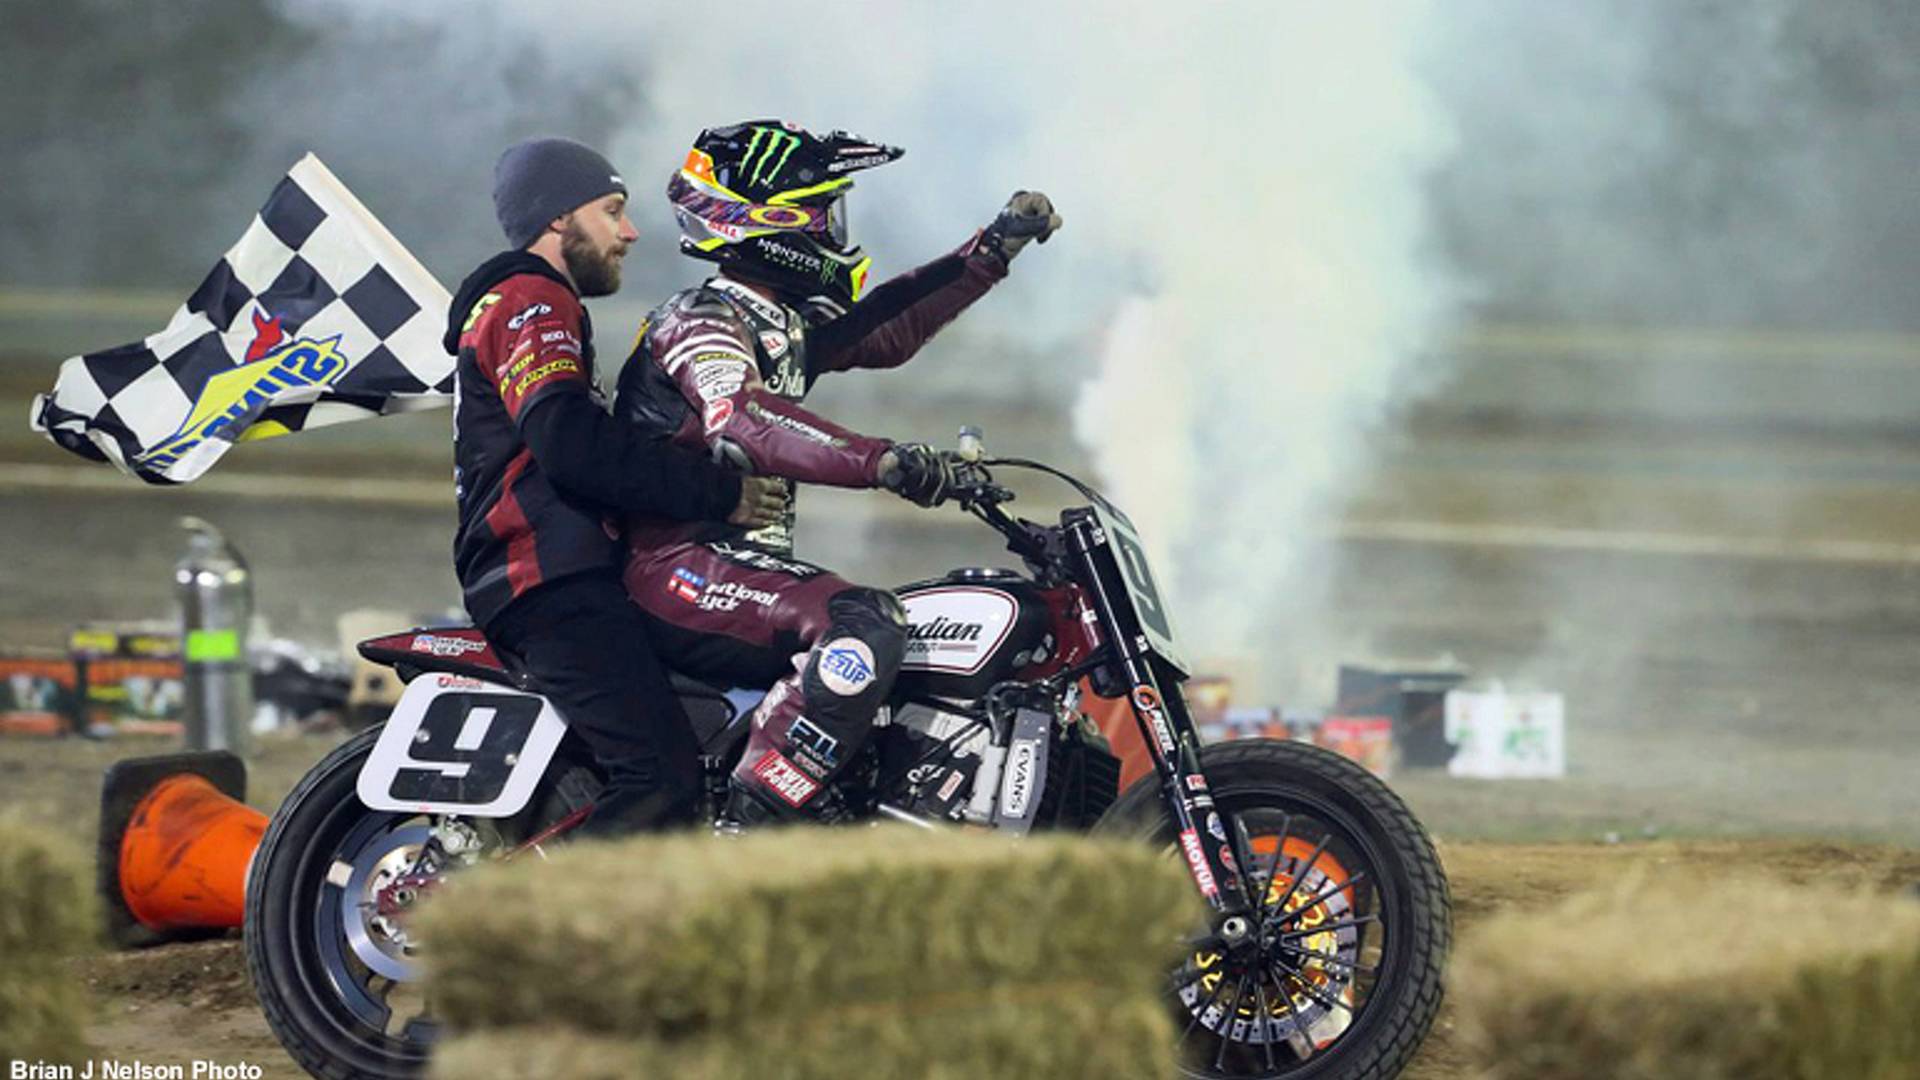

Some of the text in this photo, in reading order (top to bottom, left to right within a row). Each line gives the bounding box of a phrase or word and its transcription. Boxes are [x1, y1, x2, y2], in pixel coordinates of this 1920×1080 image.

[757, 238, 821, 271] MONSTER
[1112, 526, 1173, 643] 9
[907, 609, 983, 641] ndian
[387, 691, 545, 803] 9
[1010, 744, 1030, 810] EVANS
[1182, 833, 1217, 895] MOTUL
